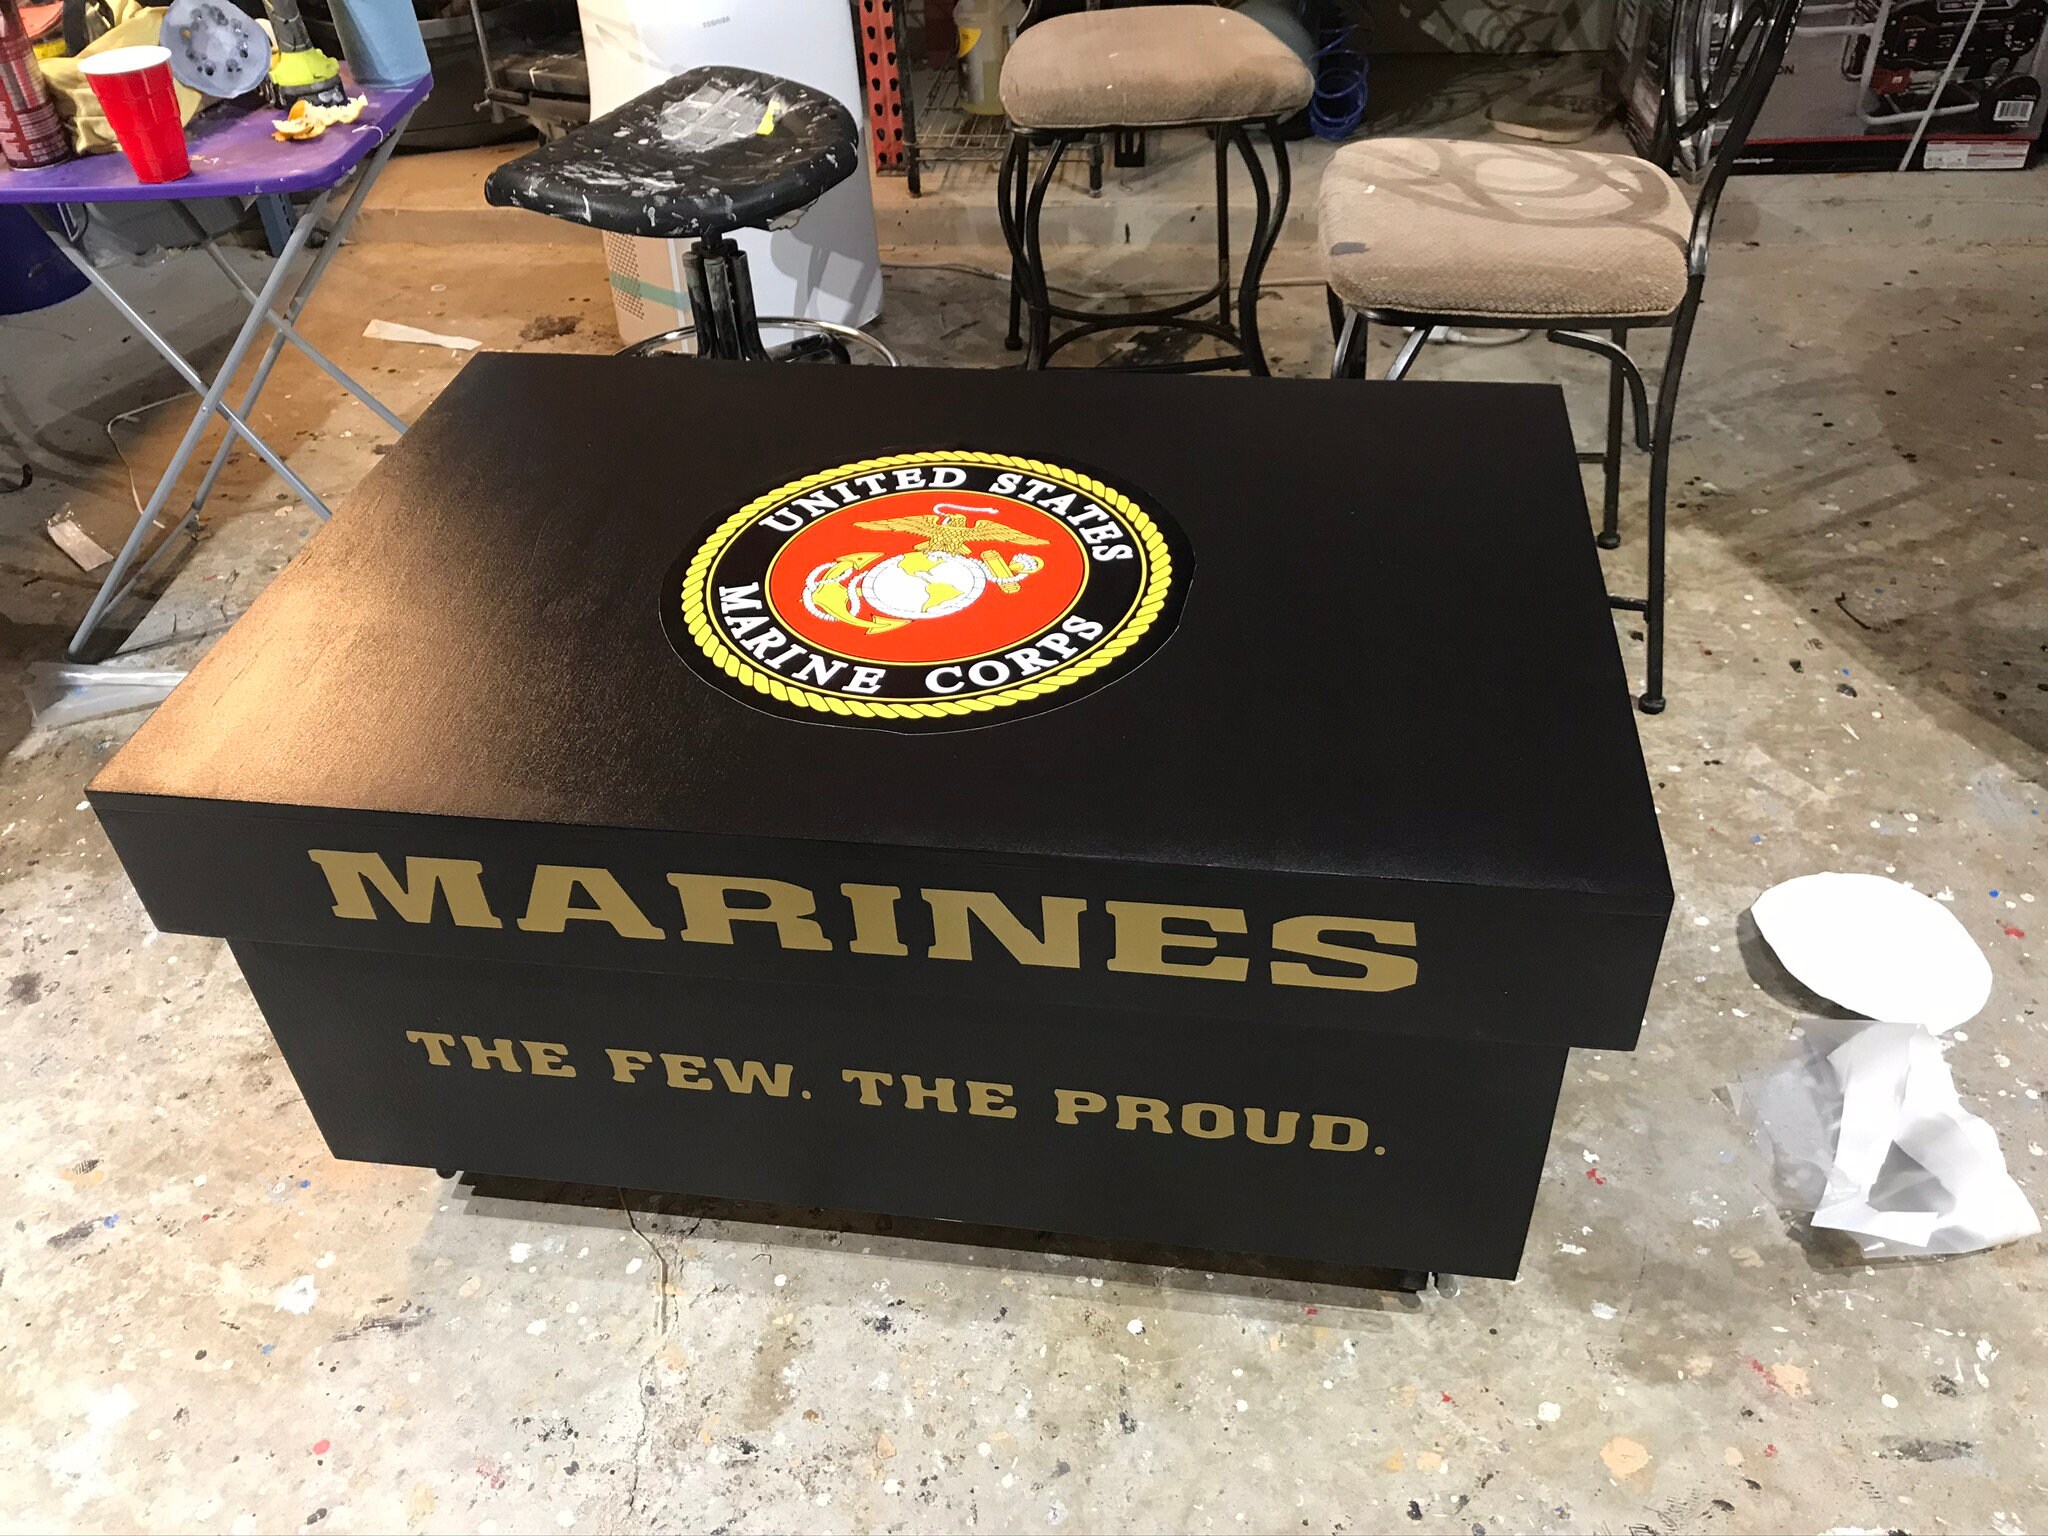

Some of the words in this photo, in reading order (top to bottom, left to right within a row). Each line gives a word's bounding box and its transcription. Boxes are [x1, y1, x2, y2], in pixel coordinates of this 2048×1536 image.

[758, 466, 967, 533] UNITED
[987, 472, 1134, 563] STATES
[718, 581, 886, 695] MARINE
[924, 615, 1105, 695] CORPS
[308, 849, 1419, 993] MARINES
[405, 1029, 577, 1079] THE
[604, 1047, 813, 1101] FEW.
[840, 1068, 1018, 1120] THE
[1053, 1088, 1387, 1156] PROUD.
